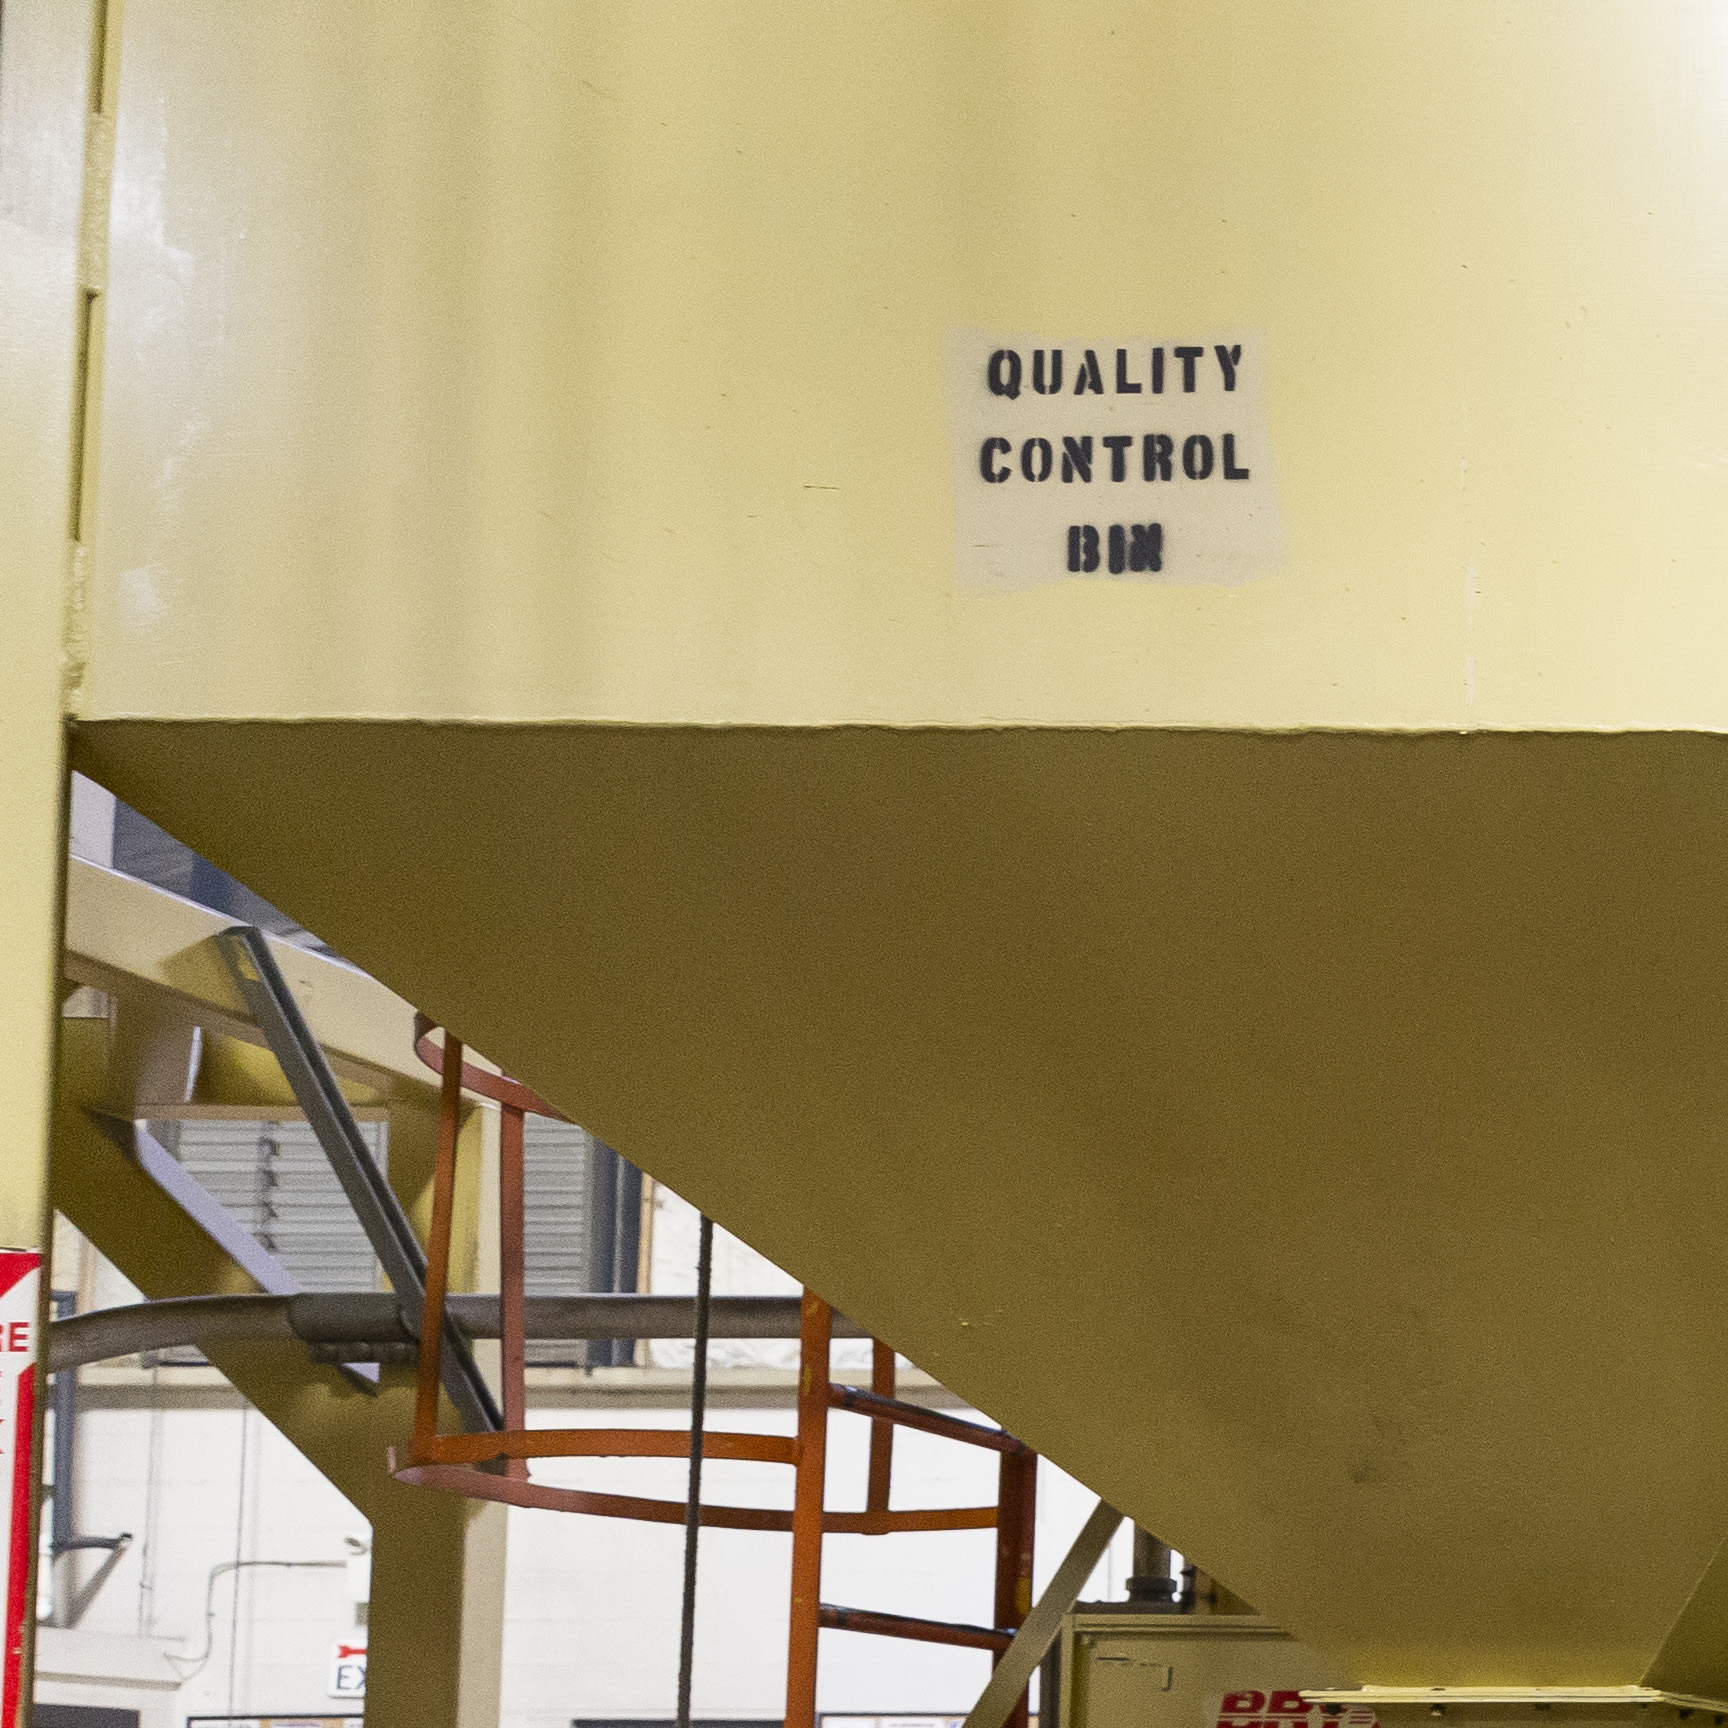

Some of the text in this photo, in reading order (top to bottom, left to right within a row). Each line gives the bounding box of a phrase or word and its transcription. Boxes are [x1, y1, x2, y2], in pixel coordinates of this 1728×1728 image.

[987, 344, 1242, 400] QUALITY
[979, 433, 1250, 484] CONTROL
[1066, 522, 1163, 574] BIN
